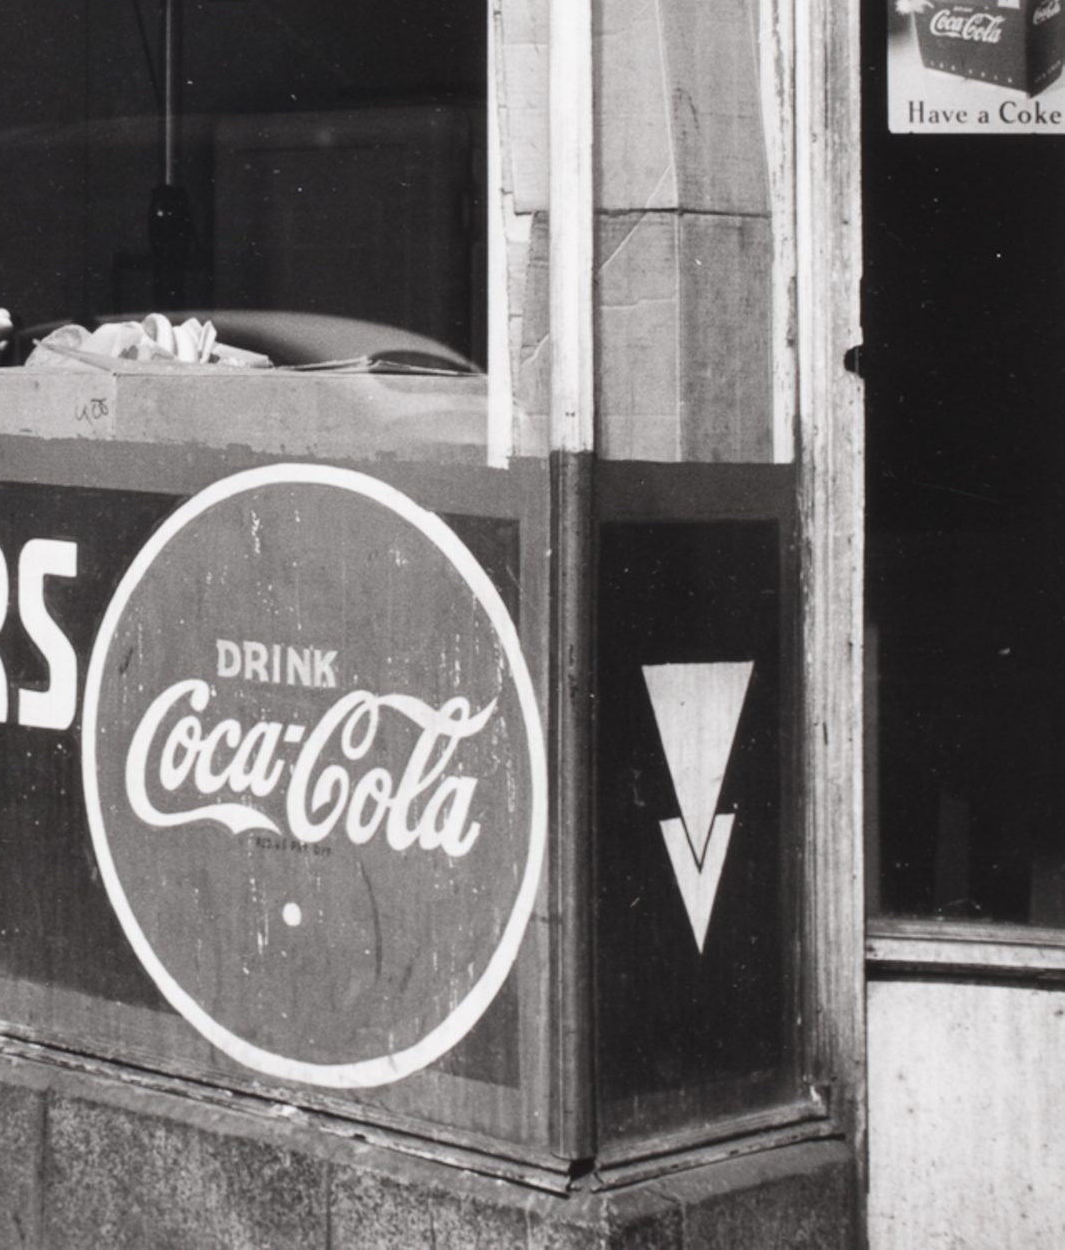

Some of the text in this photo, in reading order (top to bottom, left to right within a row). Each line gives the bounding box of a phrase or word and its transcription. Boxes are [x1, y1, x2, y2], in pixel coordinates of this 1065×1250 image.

[908, 99, 1063, 125] Have a Coke
[216, 638, 337, 689] DRINK
[125, 678, 498, 857] Coca-Cola
